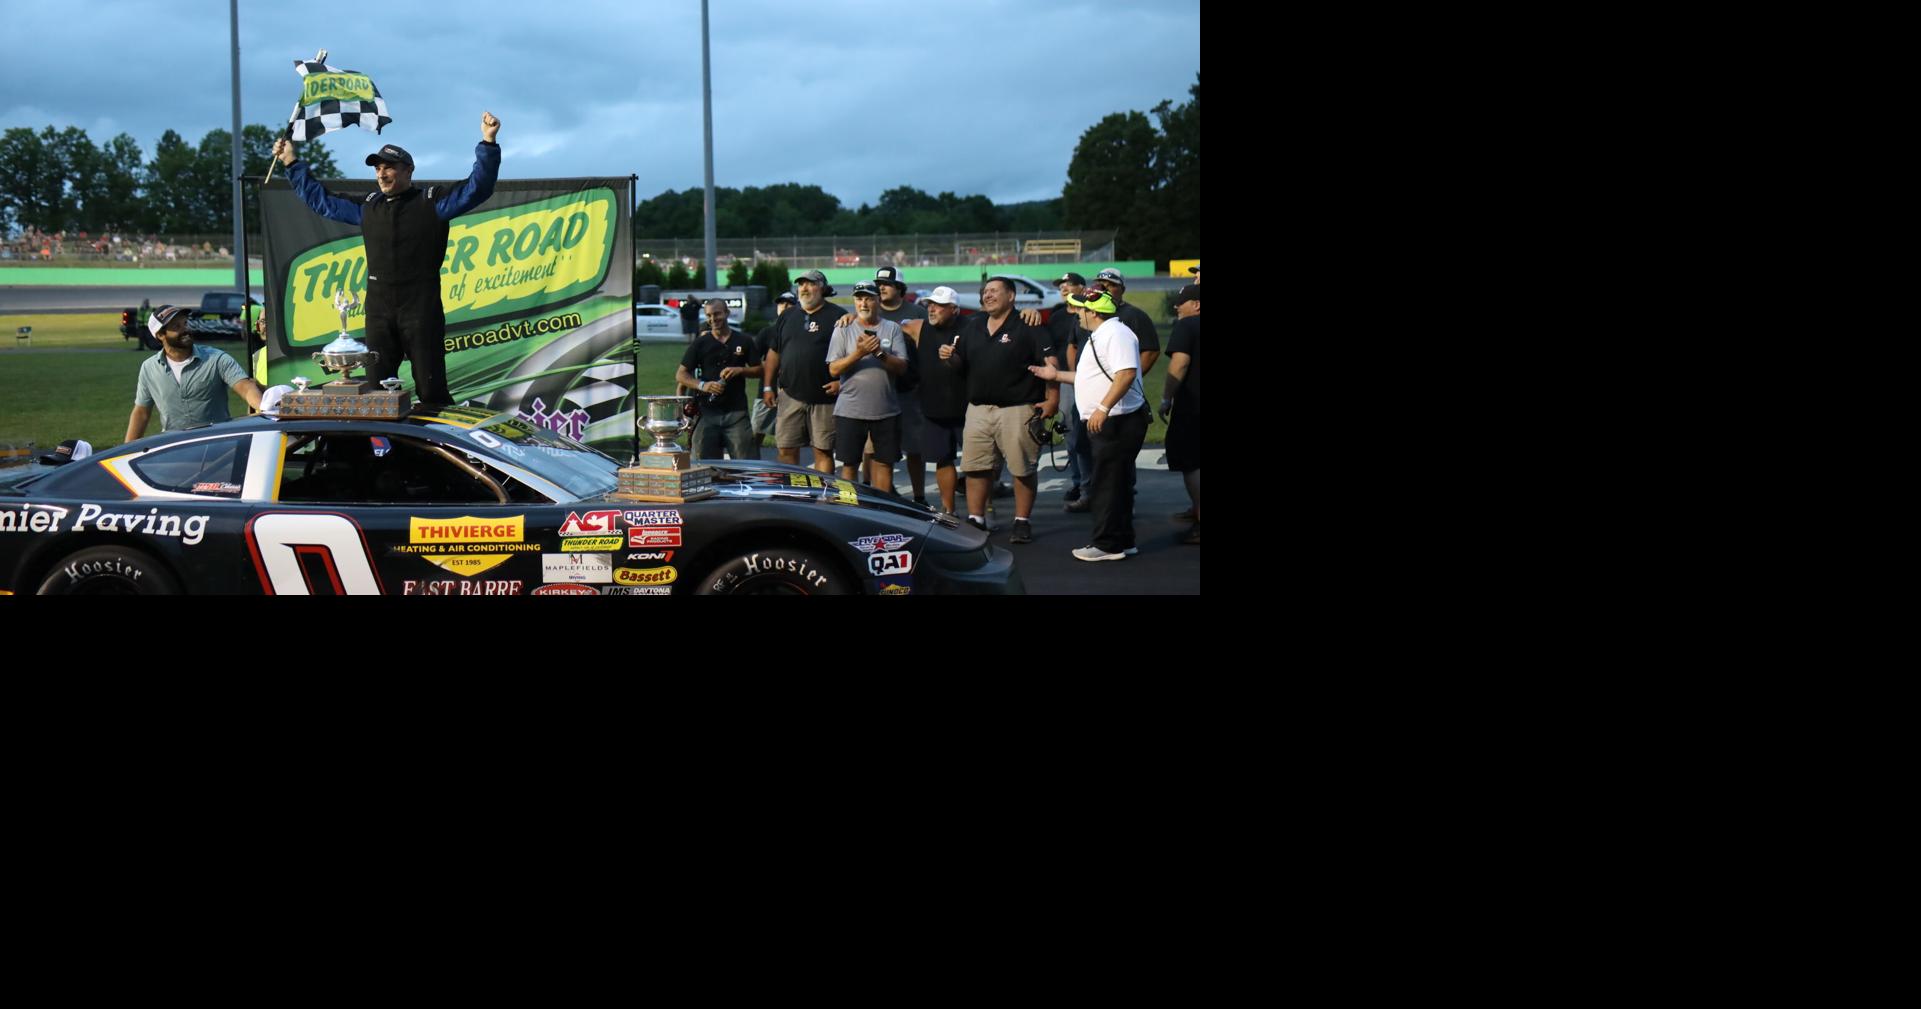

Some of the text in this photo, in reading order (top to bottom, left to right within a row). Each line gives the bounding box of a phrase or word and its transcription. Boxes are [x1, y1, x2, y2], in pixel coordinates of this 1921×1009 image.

[487, 211, 590, 267] ROAD
[450, 273, 467, 301] of
[71, 503, 210, 546] Paving
[559, 511, 622, 532] ACT
[625, 511, 677, 521] QUARTER
[634, 516, 680, 526] MASTER
[418, 525, 516, 539] THIVIERGE
[393, 543, 541, 553] HEATING & AIR CONDITIONING
[564, 539, 598, 547] THUNDER
[64, 557, 143, 585] Hoosier
[743, 553, 827, 587] Hoosier
[870, 553, 908, 575] QA1
[620, 569, 672, 583] Bassett
